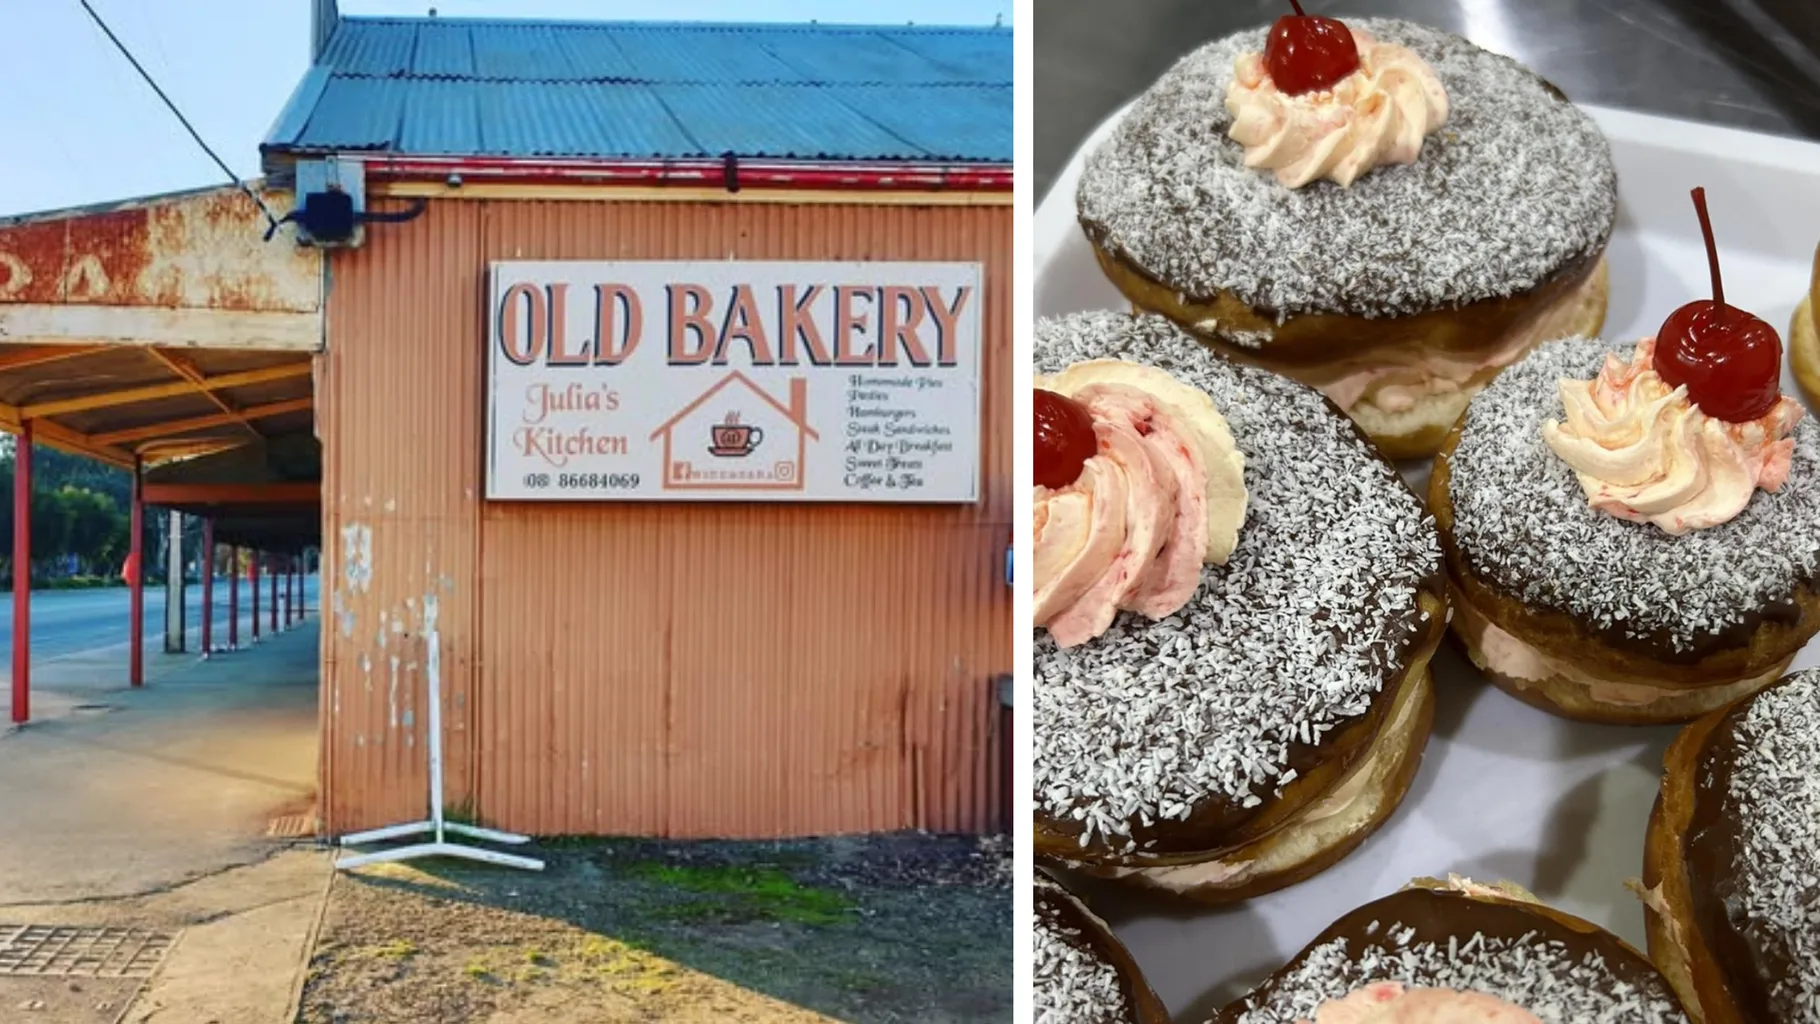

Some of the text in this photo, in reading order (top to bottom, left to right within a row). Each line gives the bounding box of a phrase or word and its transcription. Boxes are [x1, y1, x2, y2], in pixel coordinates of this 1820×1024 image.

[499, 283, 971, 366] OLD BAKERY
[522, 382, 620, 424] Julia's
[512, 425, 628, 467] Kitchen
[558, 472, 640, 488] 86684069
